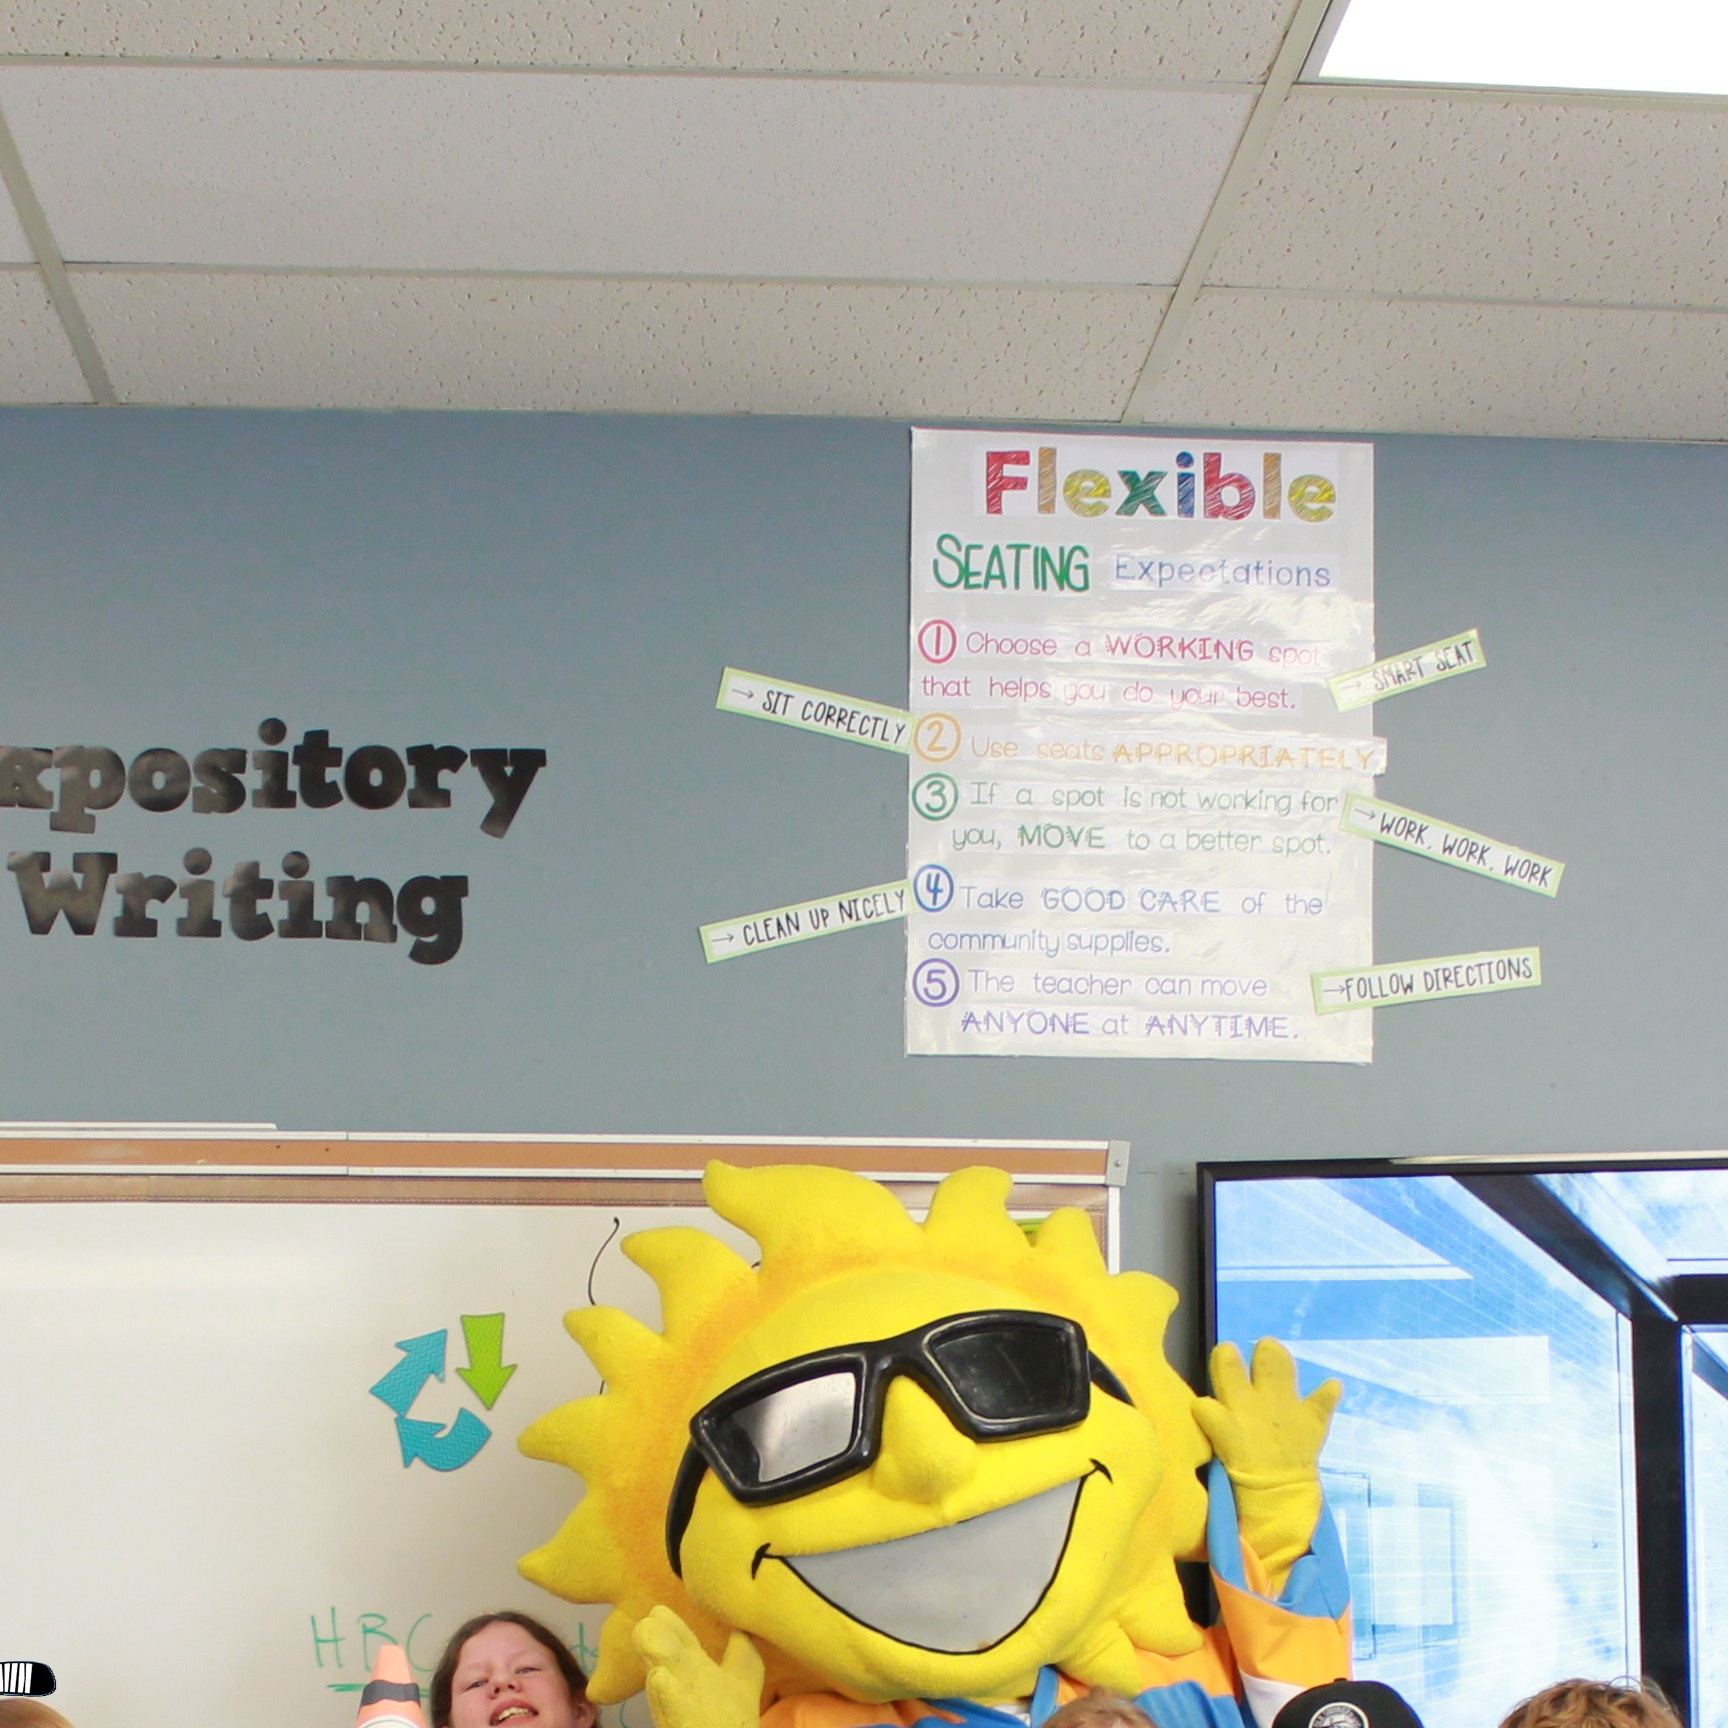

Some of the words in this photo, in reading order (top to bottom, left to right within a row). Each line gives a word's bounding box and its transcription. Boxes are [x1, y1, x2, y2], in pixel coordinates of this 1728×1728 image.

[985, 446, 1337, 524] Flexible
[932, 532, 1091, 593] SEATING
[1115, 553, 1331, 589] Expectations
[966, 630, 1058, 657] Choose
[1075, 641, 1092, 658] a
[1104, 632, 1255, 662] WORKING
[1268, 643, 1322, 669] spot
[1373, 655, 1424, 693] SMART
[1436, 639, 1474, 672] SEAT
[762, 689, 794, 716] SIT
[801, 700, 907, 745] CORRECTLY
[1504, 854, 1553, 888] WORK
[6, 846, 470, 966] Writing
[743, 911, 801, 947] CLEAN
[811, 908, 830, 930] UP
[838, 888, 905, 923] NICELY
[960, 884, 1024, 910] Take
[1041, 886, 1127, 913] GOOD
[1138, 888, 1222, 913] CARE
[1240, 891, 1266, 915] of
[1285, 893, 1323, 916] the
[967, 968, 1015, 992] The
[1032, 970, 1131, 995] teacher
[1145, 977, 1192, 997] can
[1199, 979, 1268, 998] move
[1344, 973, 1414, 1003] FOLLOW
[1423, 957, 1533, 994] DIRECTIONS
[961, 1009, 1091, 1036] ANYONE
[1101, 1014, 1129, 1036] at
[1144, 1010, 1300, 1039] ANYTIME.
